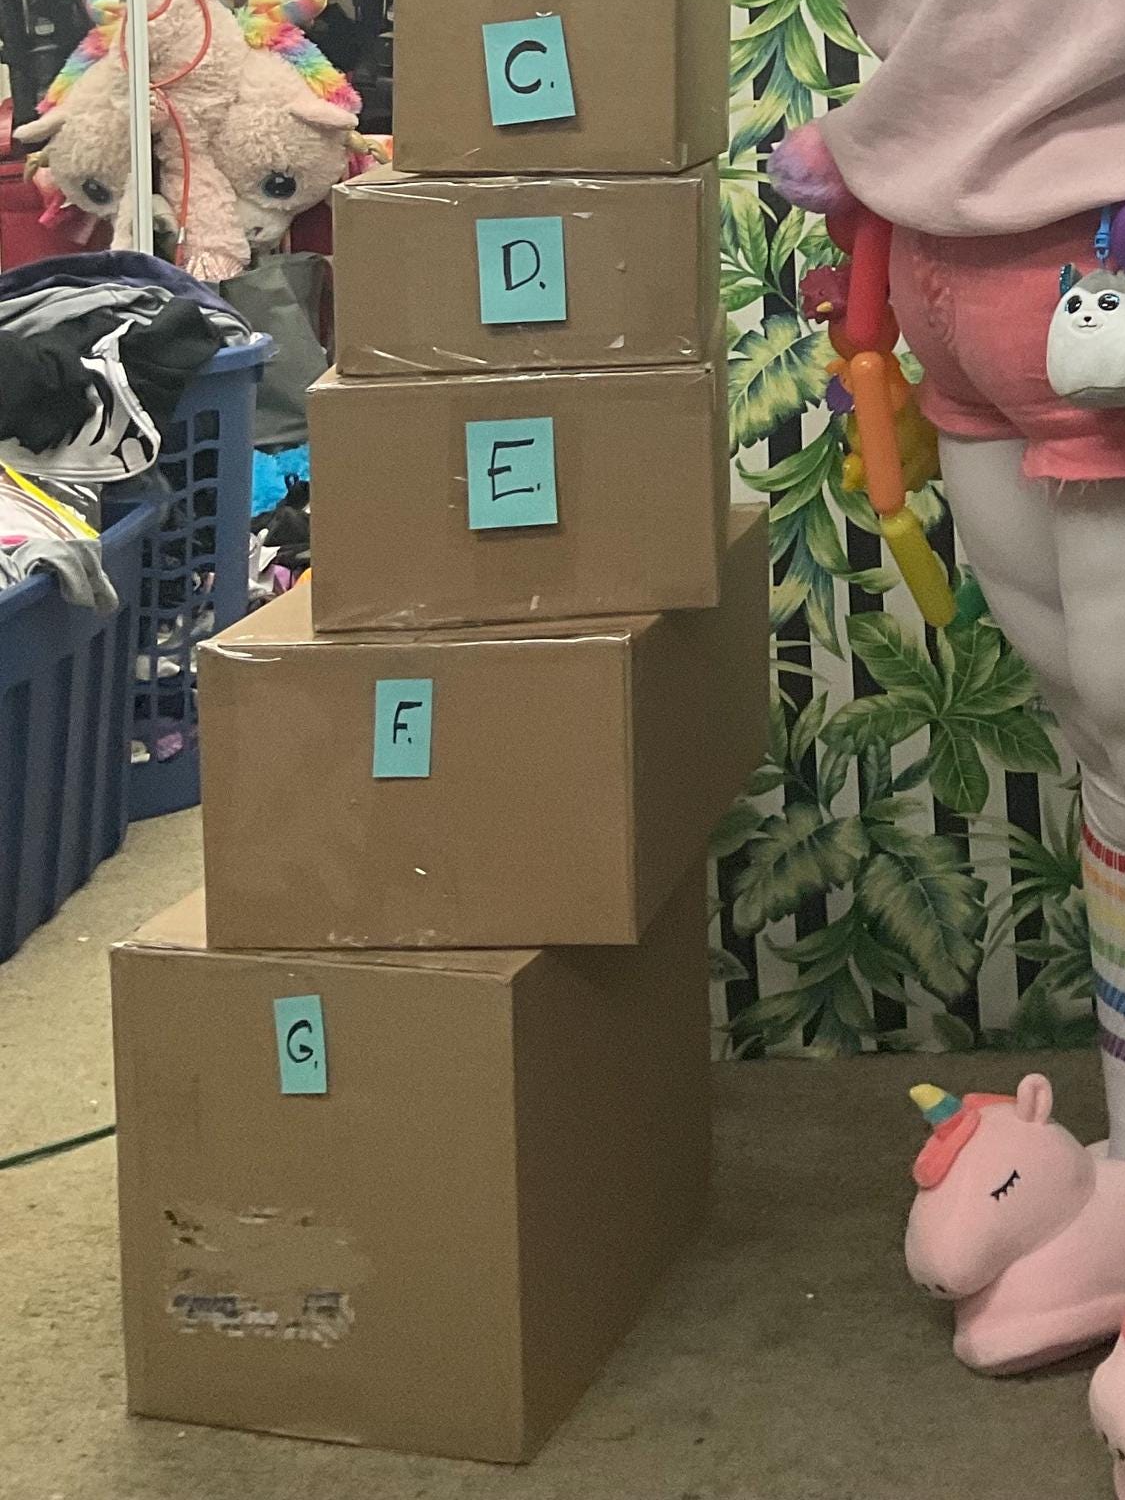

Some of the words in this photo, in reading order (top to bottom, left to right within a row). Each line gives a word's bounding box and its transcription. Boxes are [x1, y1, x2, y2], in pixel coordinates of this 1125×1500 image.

[504, 40, 555, 94] C.
[501, 239, 546, 291] D.
[487, 438, 541, 502] E.
[392, 701, 423, 744] F.
